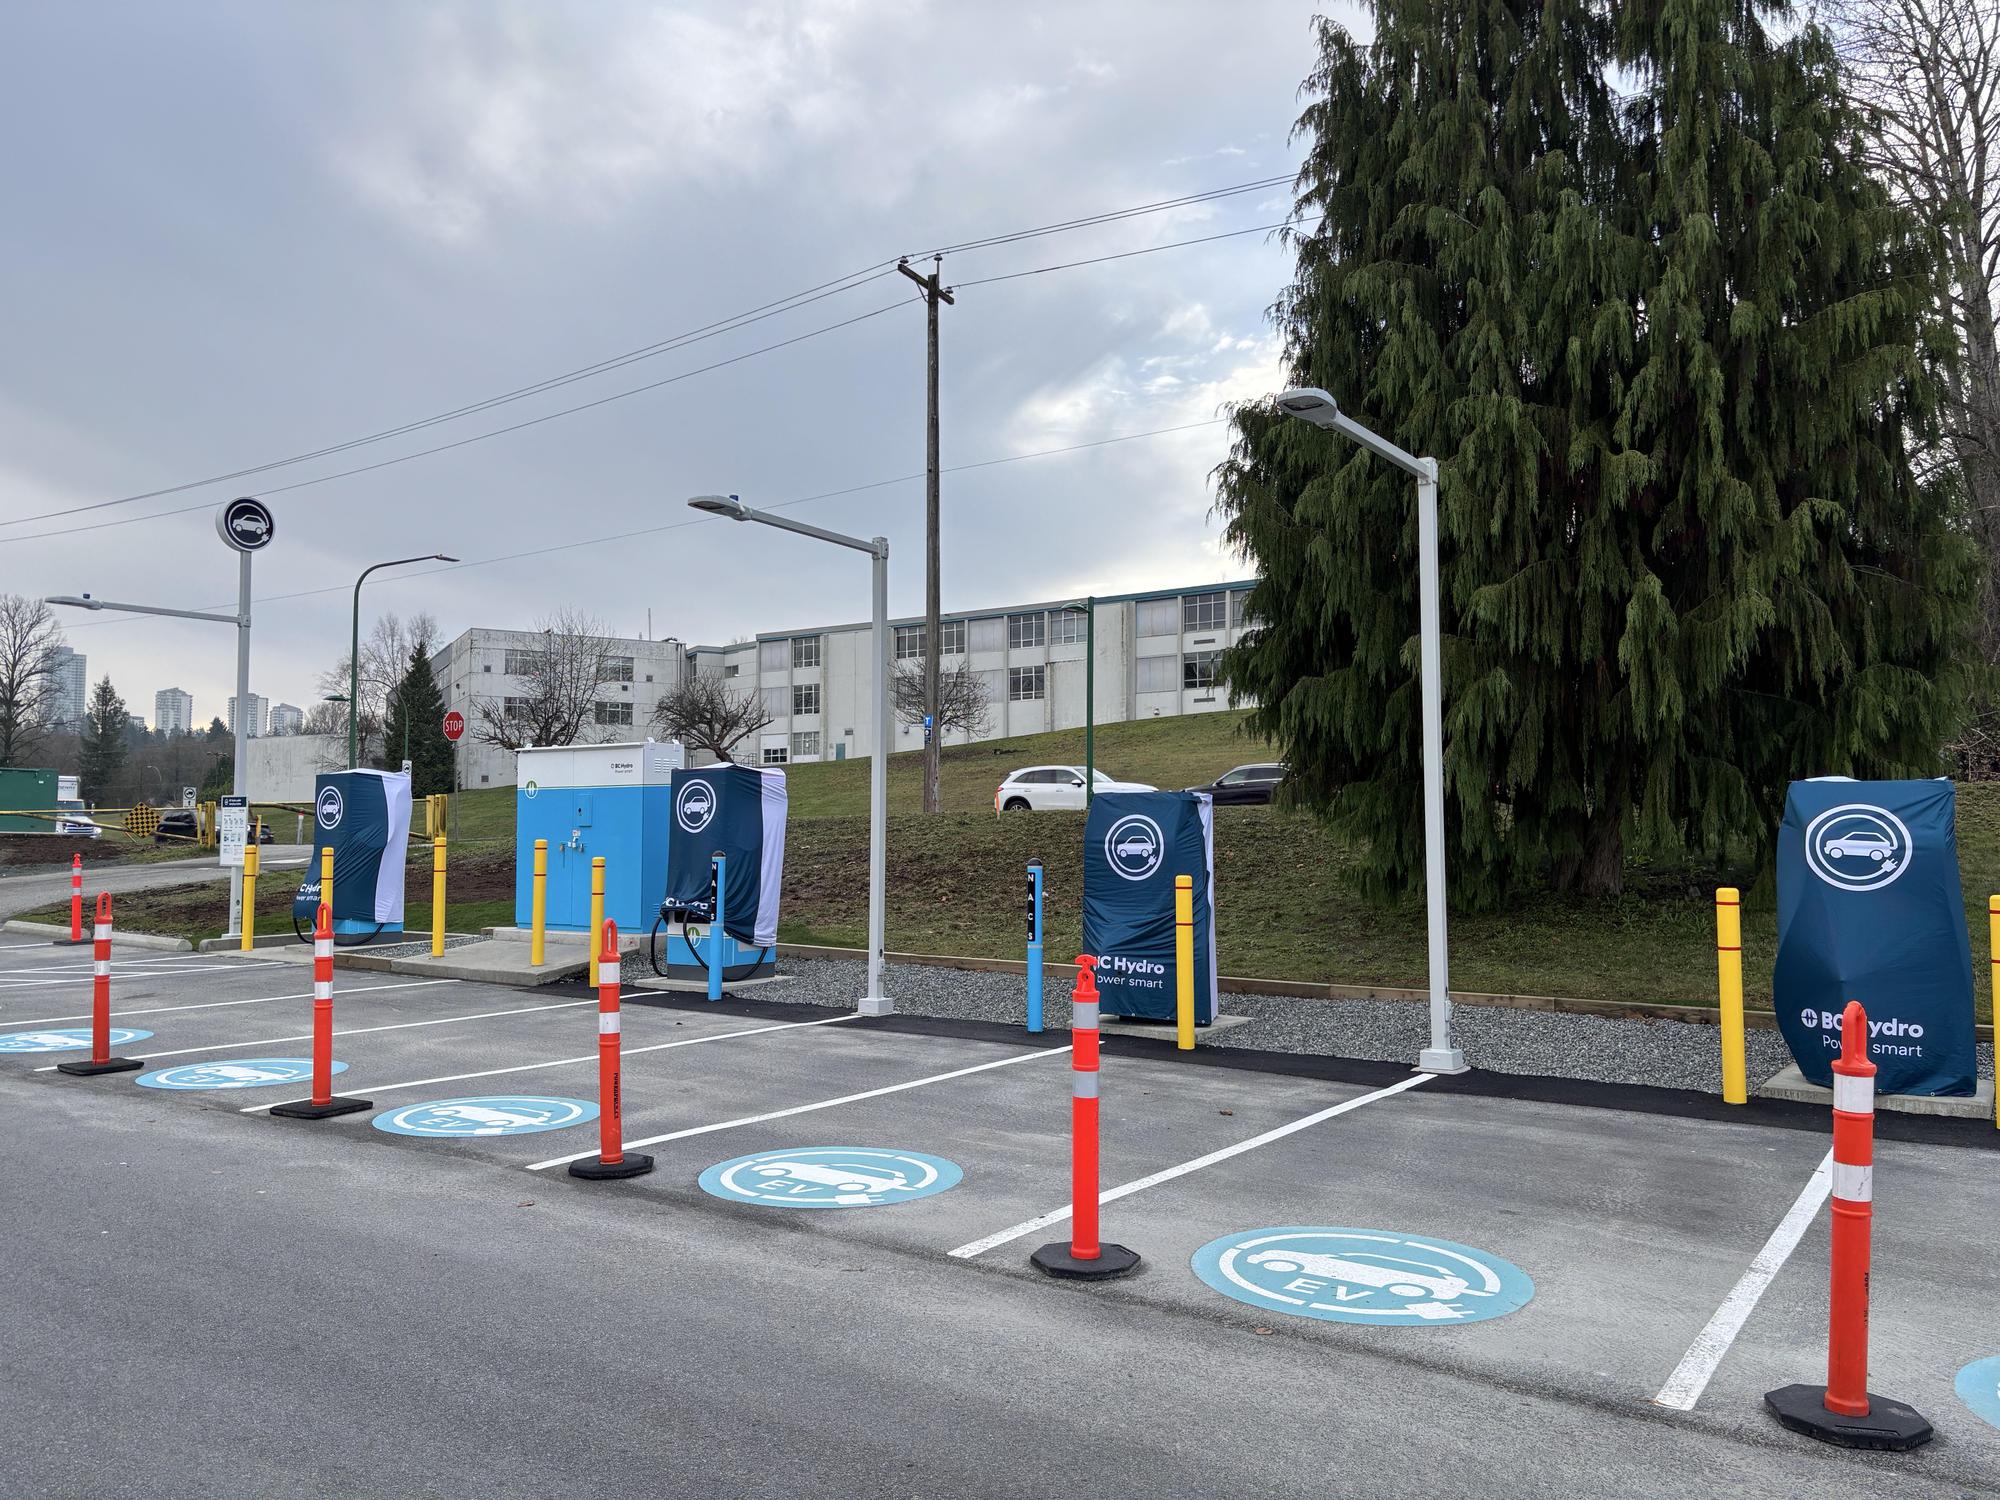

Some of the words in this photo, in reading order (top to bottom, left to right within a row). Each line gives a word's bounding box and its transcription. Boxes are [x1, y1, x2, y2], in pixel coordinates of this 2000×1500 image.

[445, 720, 463, 732] STOP
[305, 884, 322, 894] Hydr
[1094, 955, 1111, 969] C
[1114, 956, 1165, 975] Hydro
[1097, 974, 1126, 985] ower
[1128, 978, 1163, 989] smart
[1868, 1018, 1924, 1038] ydro
[1872, 1043, 1923, 1058] smart
[418, 1117, 473, 1128] EV
[755, 1179, 824, 1194] EV
[1283, 1278, 1375, 1302] EV
